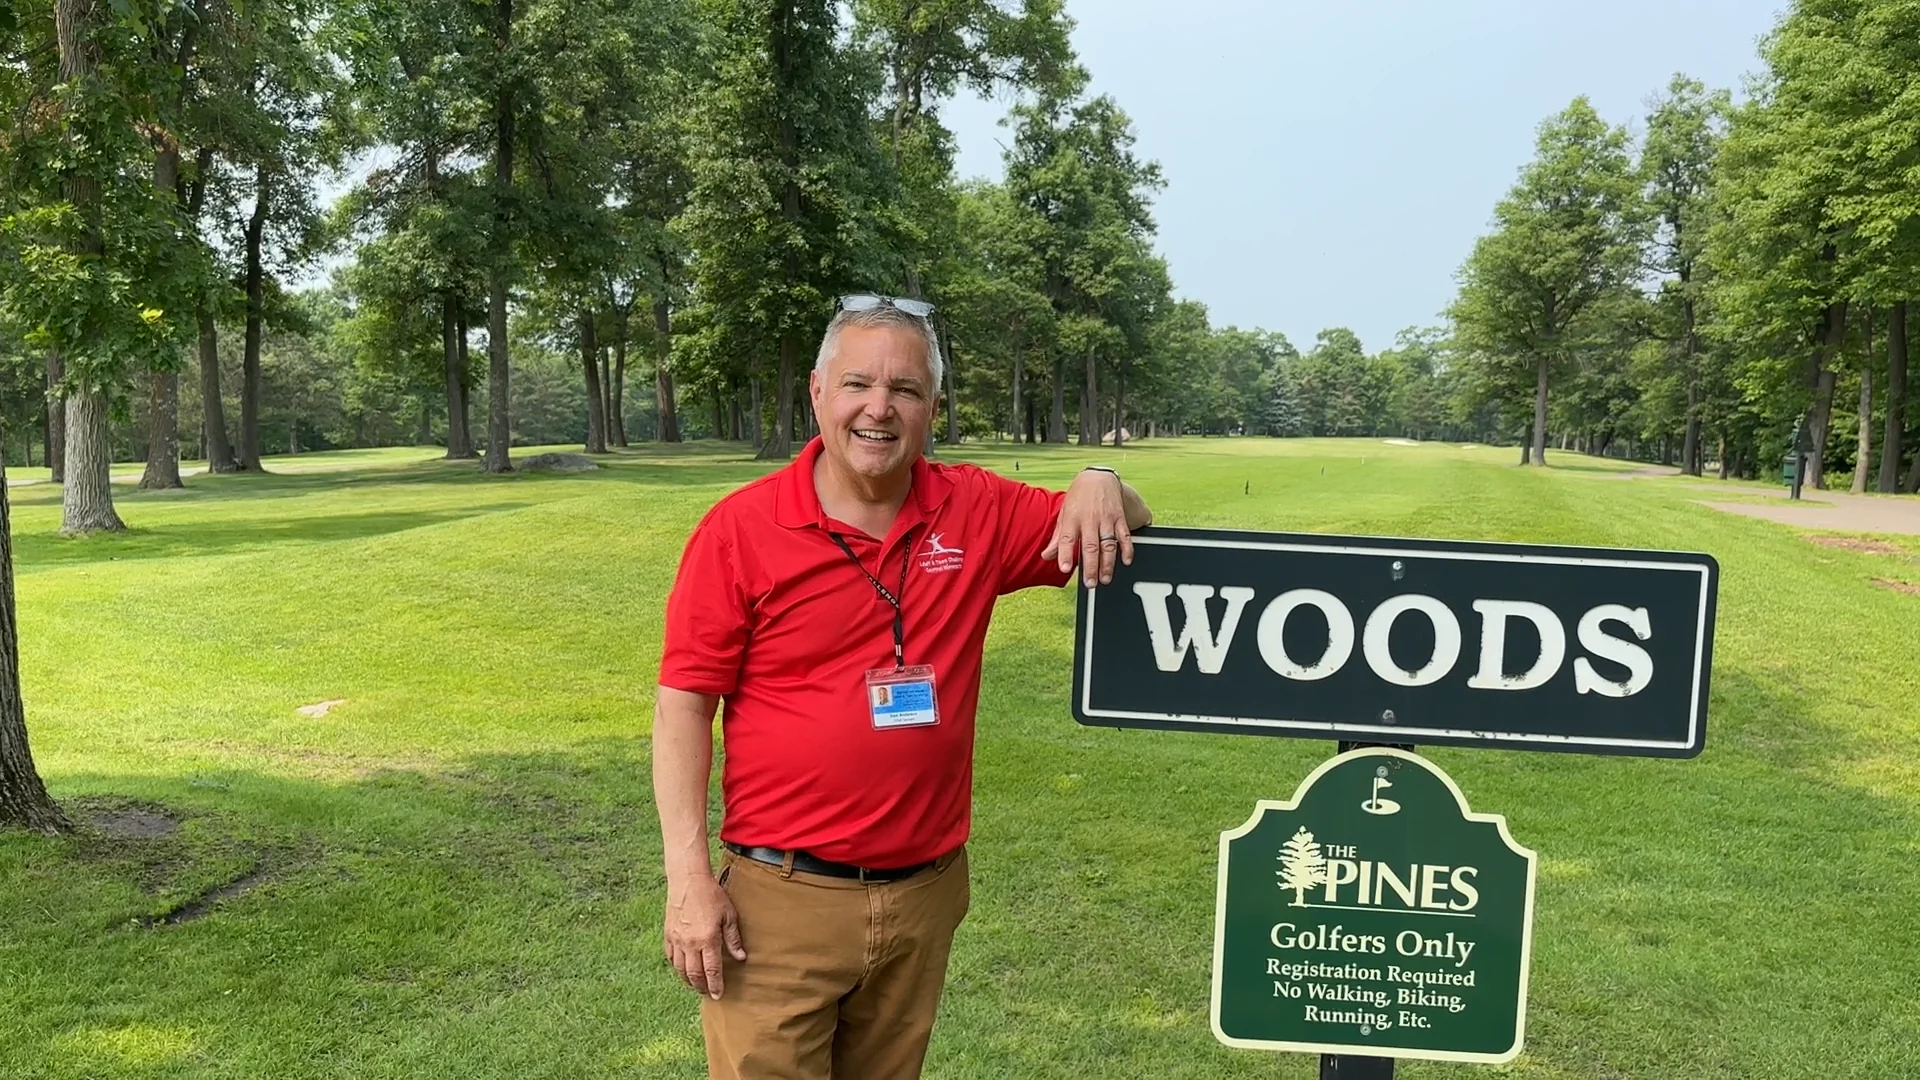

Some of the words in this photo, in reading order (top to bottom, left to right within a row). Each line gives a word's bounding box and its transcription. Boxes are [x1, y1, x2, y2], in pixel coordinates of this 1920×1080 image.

[1132, 581, 1654, 698] WOODS
[1325, 844, 1357, 859] THE
[1324, 858, 1479, 911] PINES
[1270, 922, 1386, 954] Golfers
[1395, 930, 1475, 967] Only
[1266, 958, 1382, 981] Registration
[1386, 965, 1476, 988] Required
[1272, 981, 1302, 999] No
[1306, 982, 1392, 1008] Walking,
[1397, 988, 1466, 1012] Biking,
[1304, 1005, 1393, 1030] Running,
[1398, 1010, 1432, 1029] Etc.
